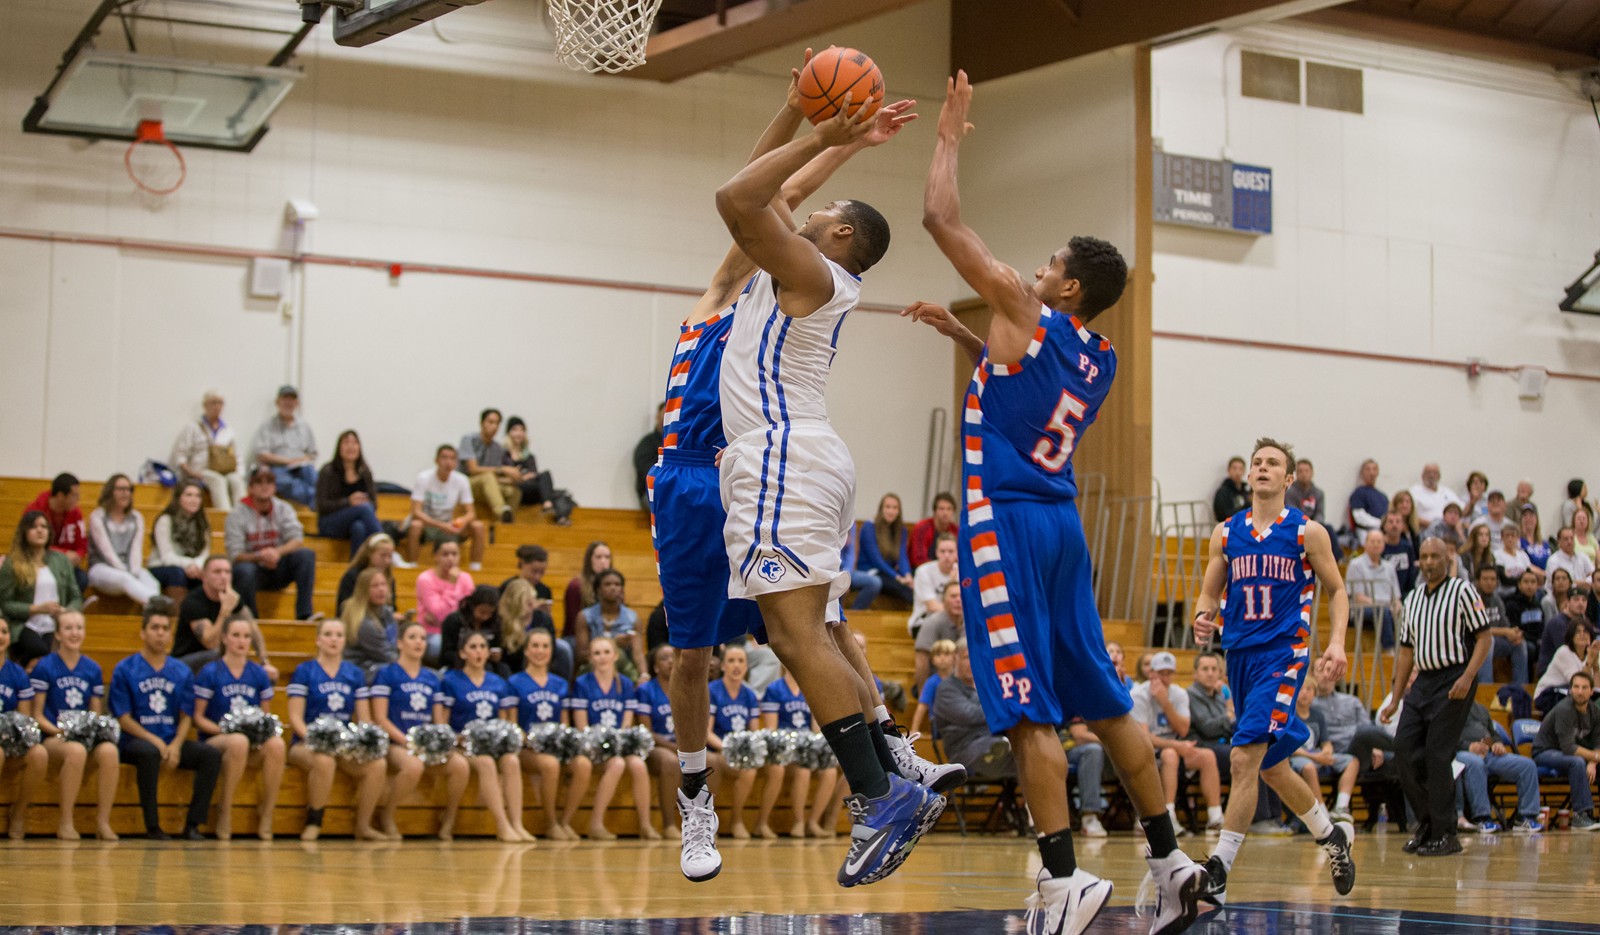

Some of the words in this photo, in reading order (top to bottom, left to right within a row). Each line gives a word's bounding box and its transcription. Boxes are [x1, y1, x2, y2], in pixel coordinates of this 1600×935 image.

[1233, 169, 1270, 192] GUEST
[1173, 188, 1212, 207] TIME
[1172, 207, 1214, 223] PERIOD
[1030, 388, 1089, 473] 5
[1242, 585, 1275, 621] 11
